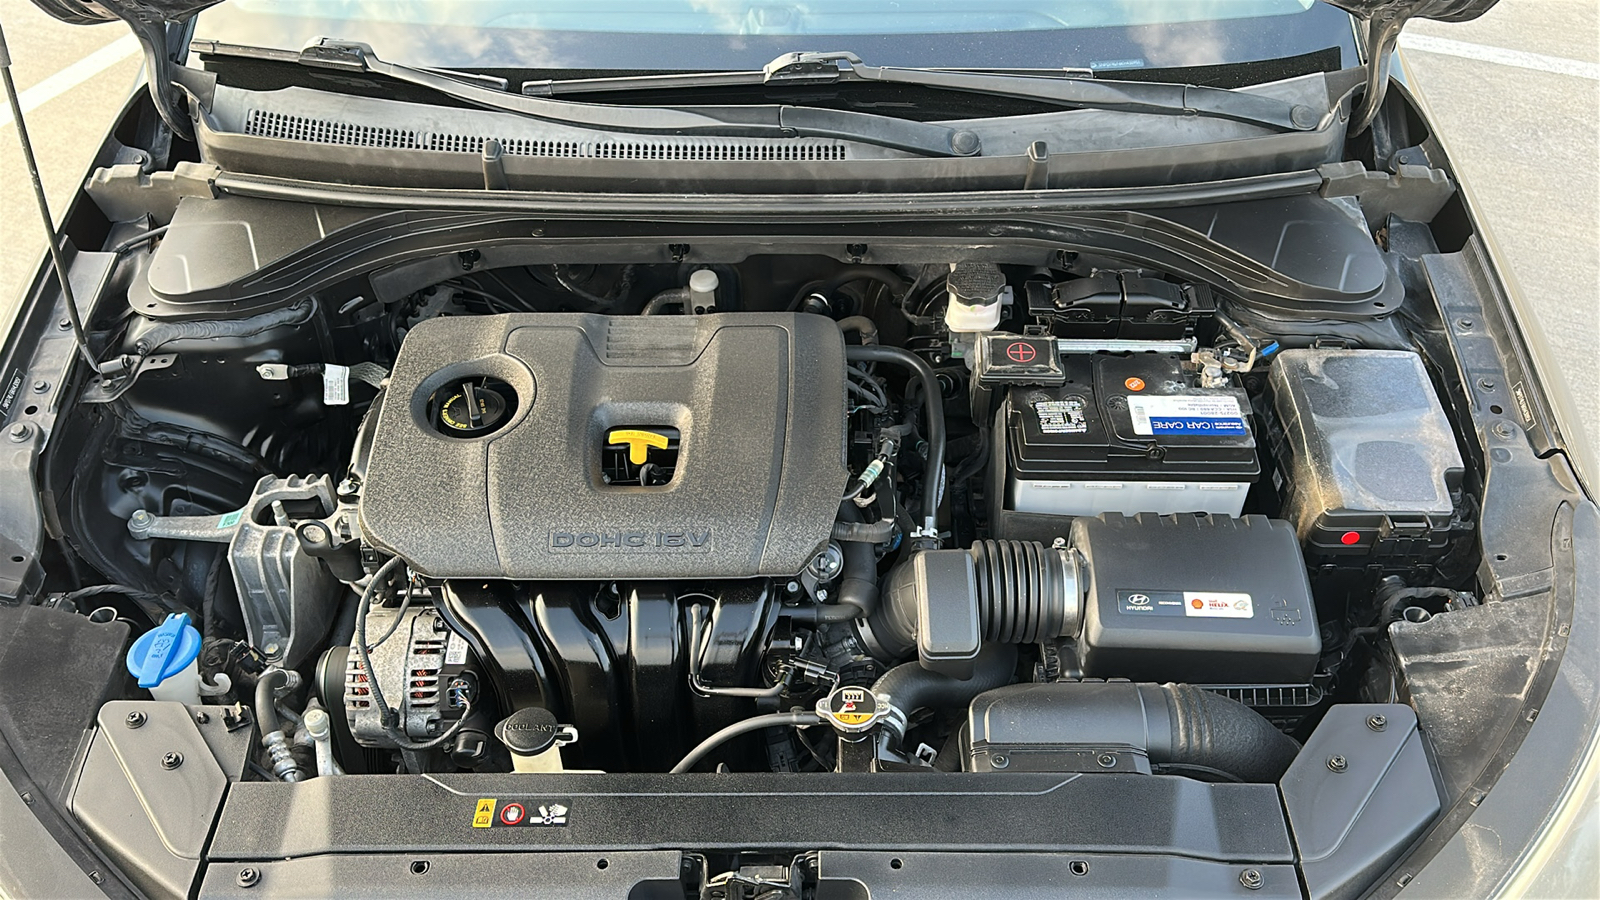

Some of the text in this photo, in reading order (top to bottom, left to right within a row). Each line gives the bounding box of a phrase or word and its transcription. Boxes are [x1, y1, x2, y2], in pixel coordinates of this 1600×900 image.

[1153, 421, 1211, 429] CAR CARE
[552, 531, 710, 547] DOHC 16V
[505, 723, 554, 732] COOLANT
